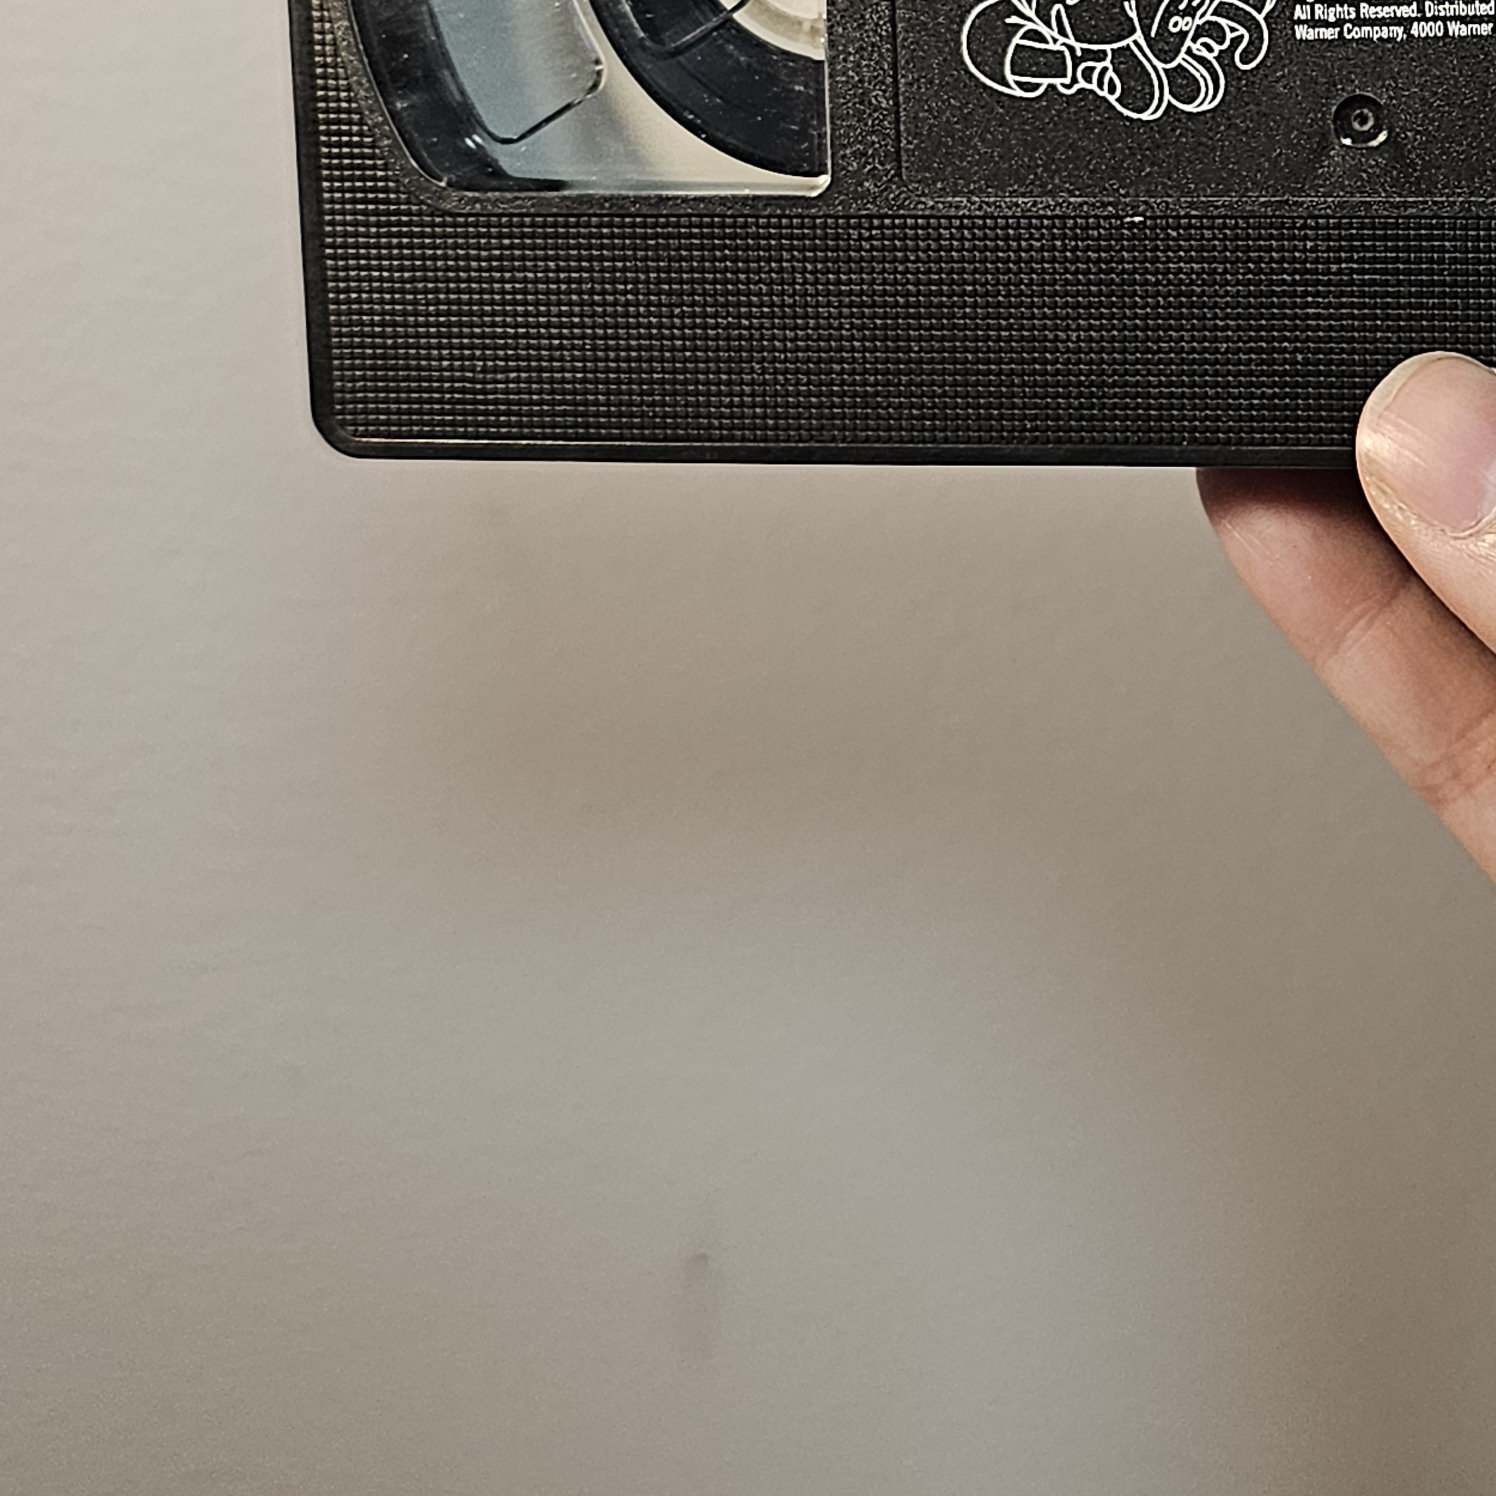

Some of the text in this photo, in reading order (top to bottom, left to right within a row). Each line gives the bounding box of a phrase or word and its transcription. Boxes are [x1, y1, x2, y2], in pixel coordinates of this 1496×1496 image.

[1294, 4, 1311, 20] All
[1314, 3, 1356, 22] Rights
[1360, 1, 1421, 19] Reserved.
[1424, 0, 1495, 17] Distributed
[1294, 24, 1340, 41] Warner
[1343, 22, 1407, 43] Company,
[1411, 21, 1444, 37] 4000
[1447, 20, 1493, 38] Warner
